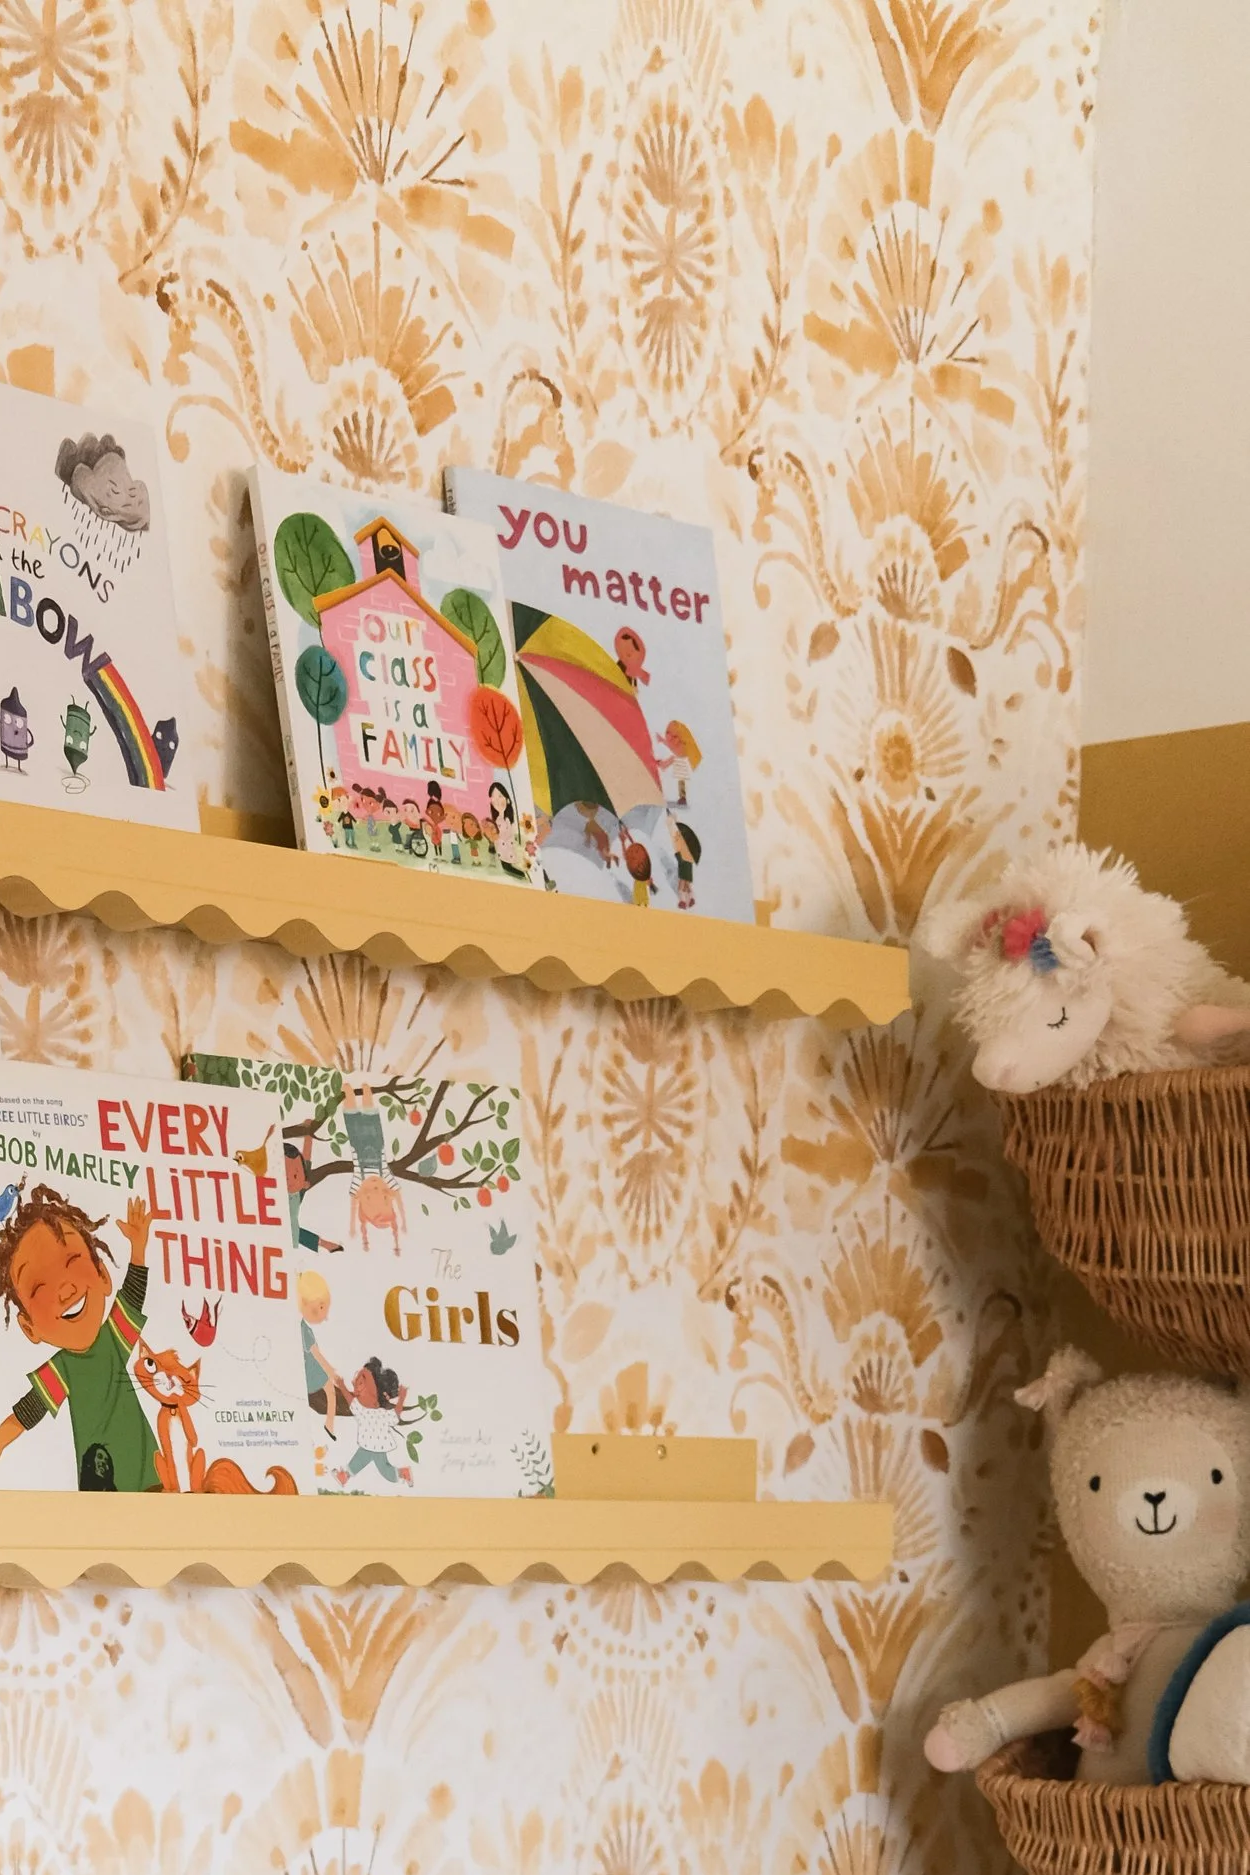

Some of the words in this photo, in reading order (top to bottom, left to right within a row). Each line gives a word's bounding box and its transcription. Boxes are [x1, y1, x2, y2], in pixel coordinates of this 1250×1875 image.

[497, 504, 588, 554] you
[12, 548, 45, 579] the
[561, 563, 710, 624] matter
[270, 644, 285, 684] FAMILY
[383, 696, 400, 722] is
[412, 703, 429, 729] a
[360, 722, 465, 781] FAMILY
[17, 1111, 51, 1125] LITTLE
[33, 1097, 44, 1105] the
[32, 1130, 41, 1138] by
[98, 1099, 230, 1158] EVERY
[45, 1145, 139, 1189] MARLEY
[431, 1248, 462, 1280] The
[383, 1284, 520, 1347] Girls
[214, 1411, 254, 1423] CEDELLA
[256, 1410, 295, 1422] MARLEY
